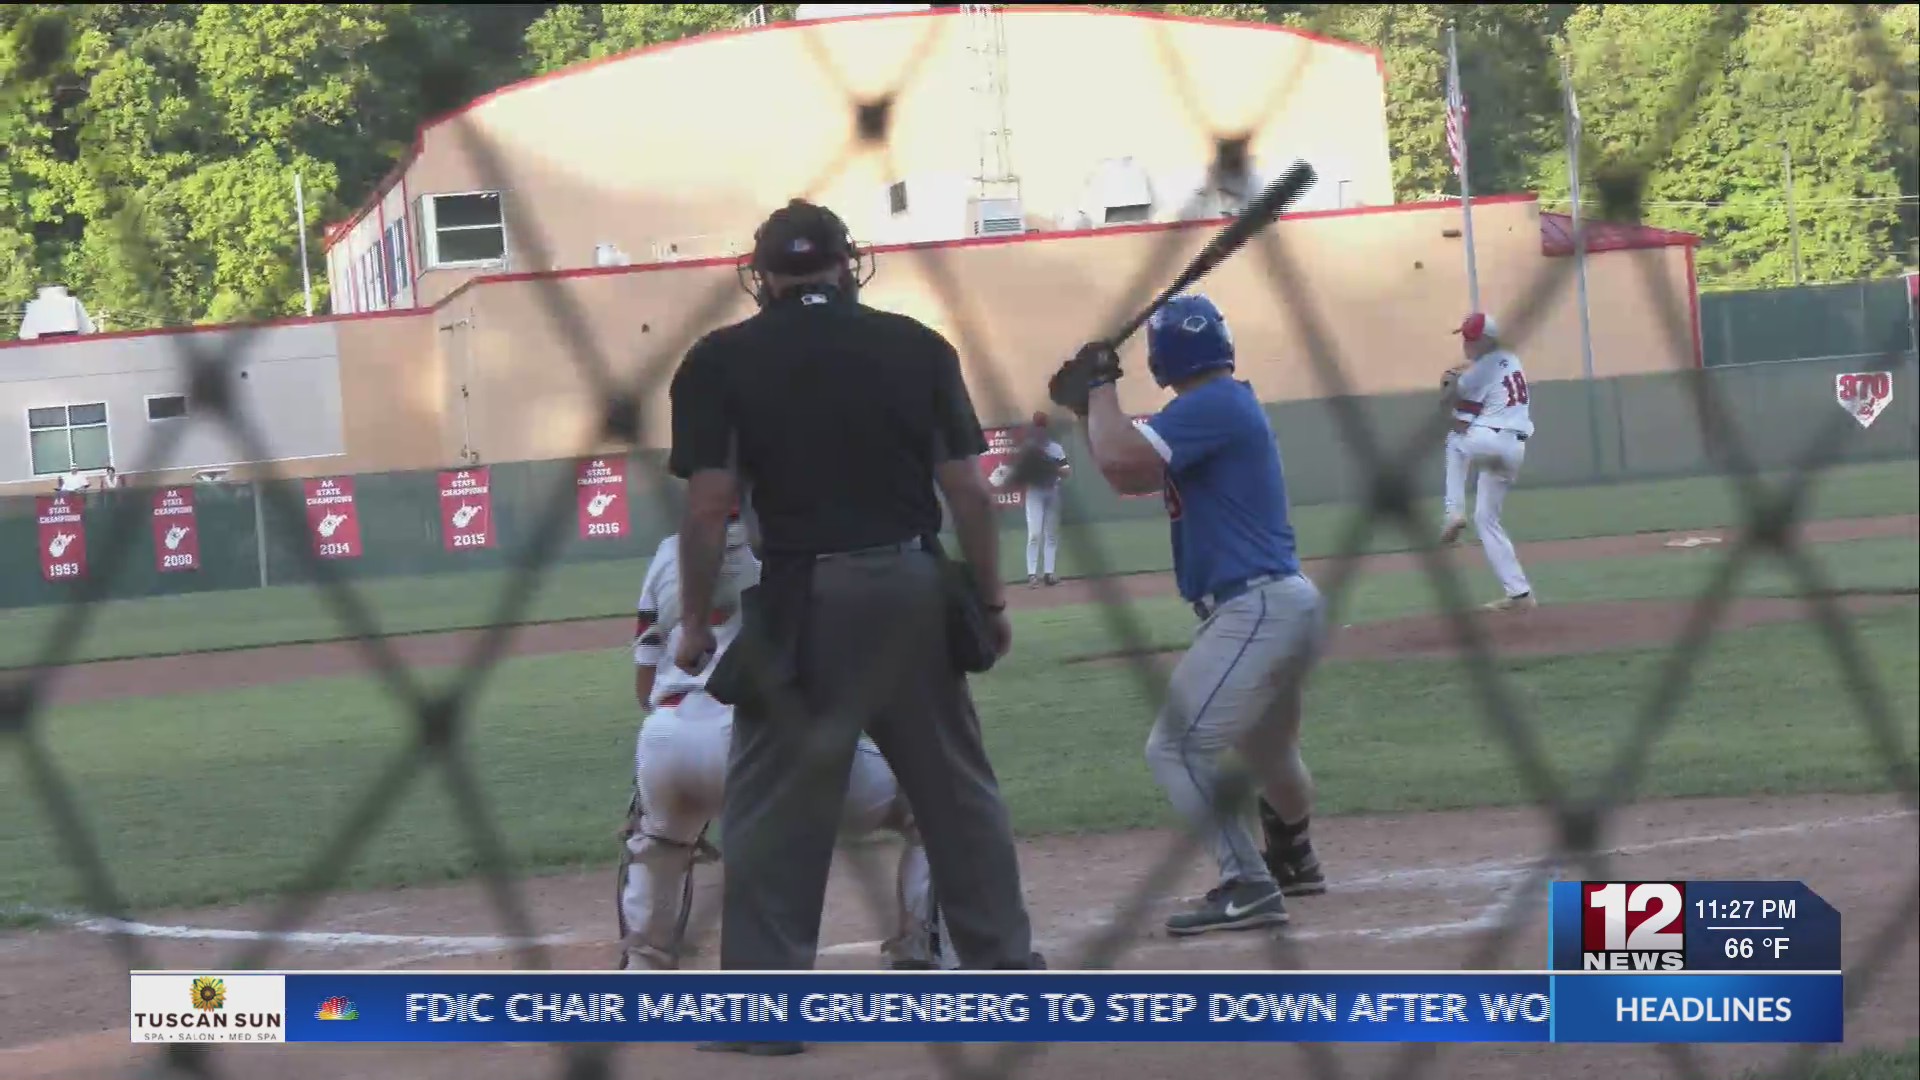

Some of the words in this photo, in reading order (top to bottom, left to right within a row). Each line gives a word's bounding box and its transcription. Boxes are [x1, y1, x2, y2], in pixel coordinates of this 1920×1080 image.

[1501, 371, 1528, 407] 18
[1840, 373, 1889, 400] 370
[457, 471, 470, 479] AA
[586, 467, 612, 476] STATE
[321, 480, 334, 488] AA
[452, 478, 477, 487] STATE
[166, 490, 178, 498] AA
[316, 488, 341, 496] STATE
[441, 486, 488, 497] CHAMPIONS
[162, 498, 183, 506] STATE
[306, 495, 353, 506] CHAMPIONS
[48, 507, 71, 515] STATE
[153, 506, 194, 516] CHAMPIONS
[39, 514, 81, 524] CHAMPIONS
[588, 522, 620, 535] 2016
[454, 533, 486, 546] 2015
[320, 542, 350, 555] 2014
[163, 553, 193, 567] 2000
